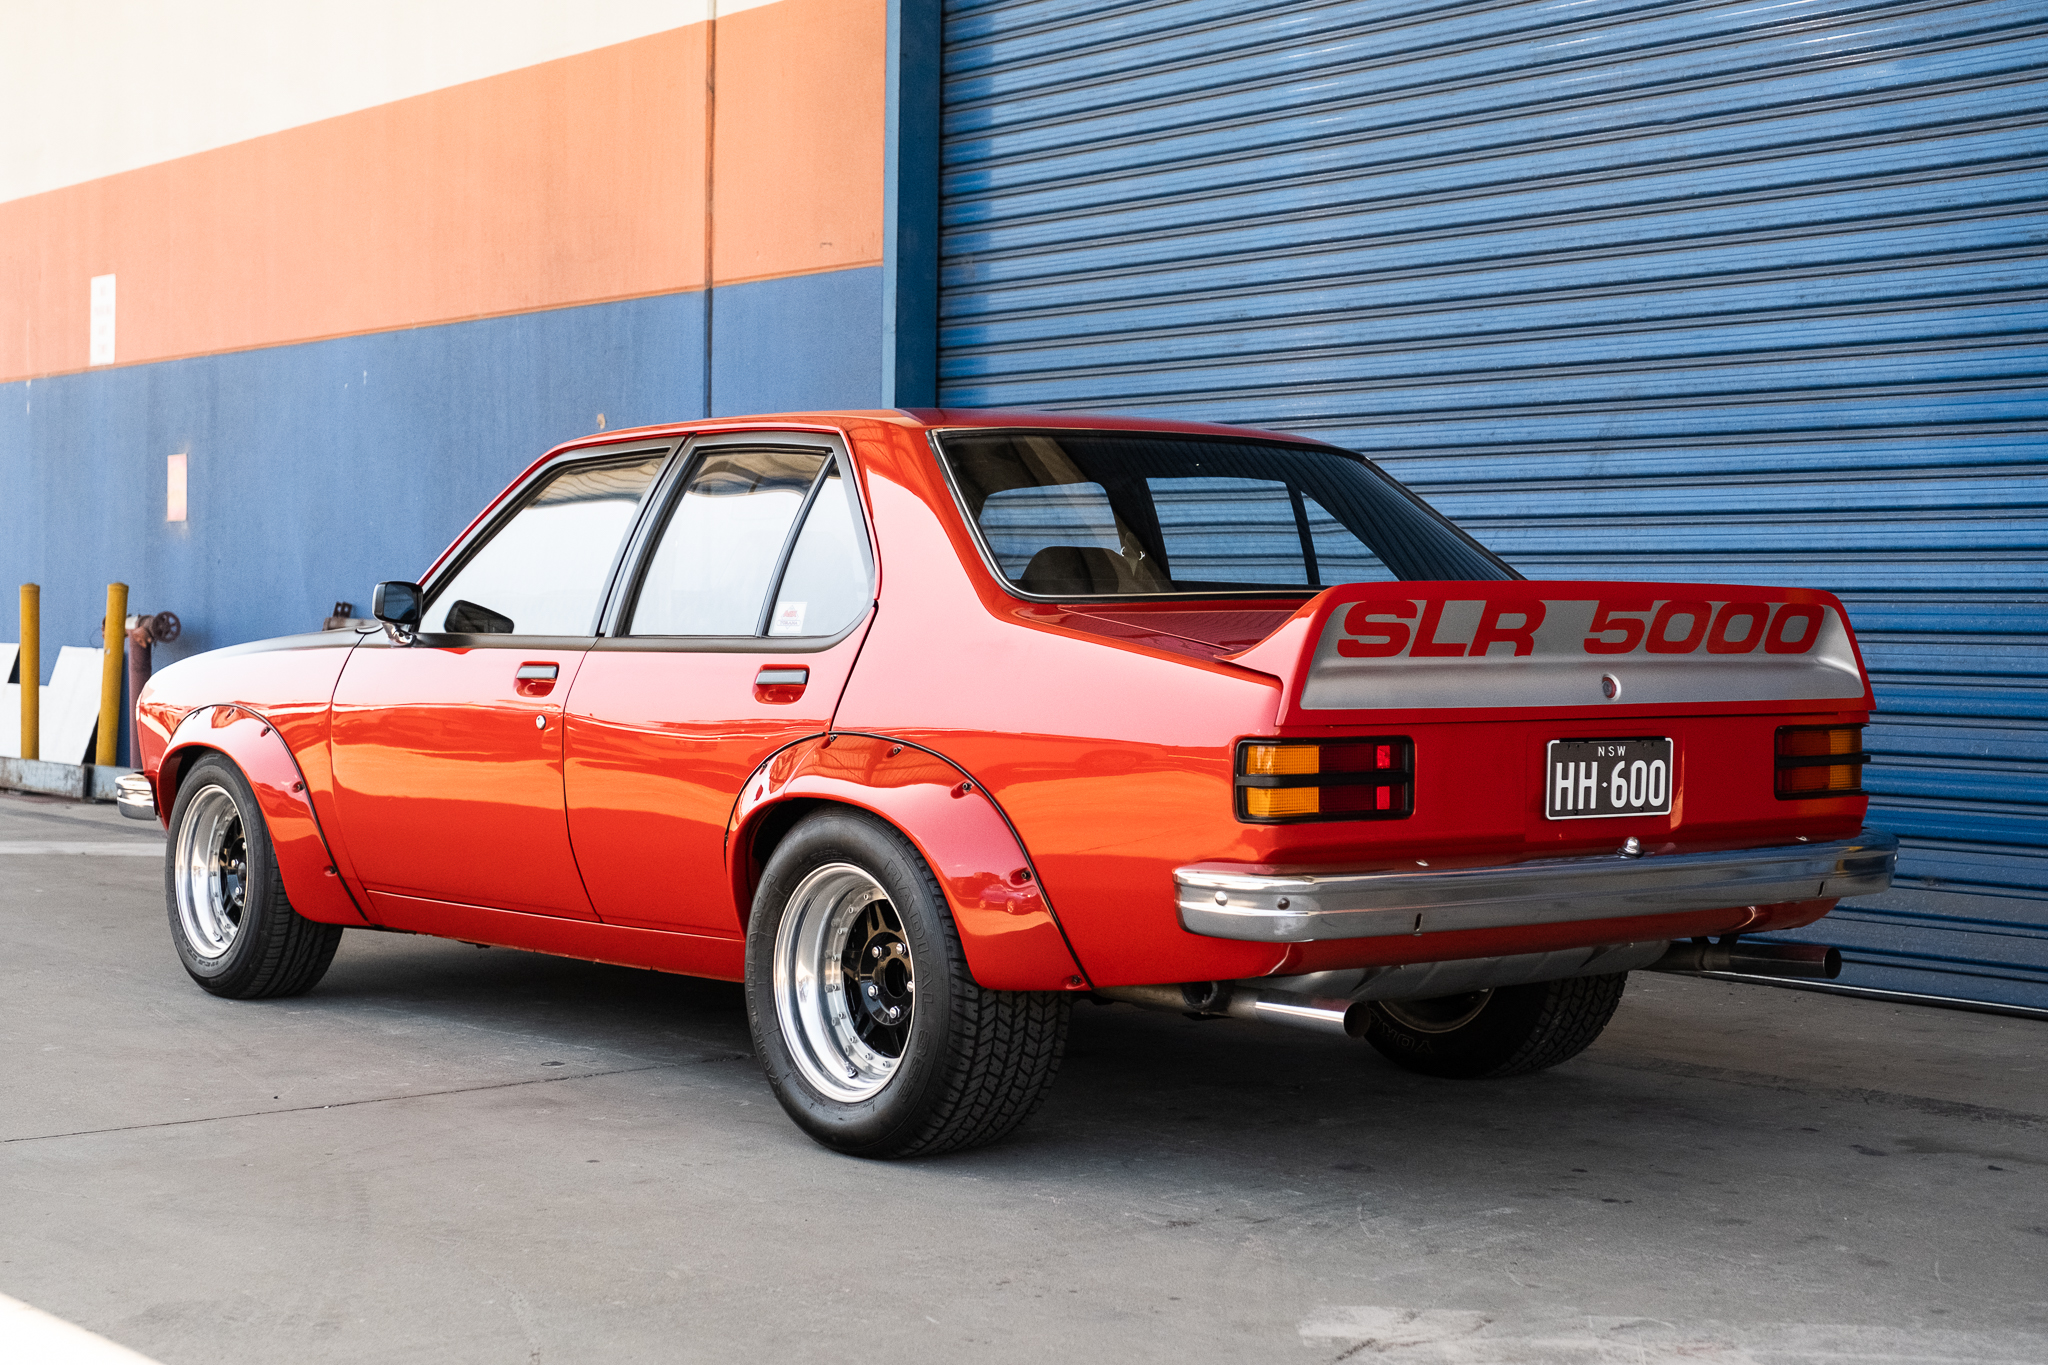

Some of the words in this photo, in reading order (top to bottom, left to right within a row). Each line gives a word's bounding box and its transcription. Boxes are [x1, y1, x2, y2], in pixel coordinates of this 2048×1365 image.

[1337, 599, 1547, 658] SLR
[1583, 599, 1825, 655] 5000
[1597, 745, 1626, 757] NSW
[746, 873, 784, 1092] YOKOHAMA
[884, 858, 933, 1015] RADIAL
